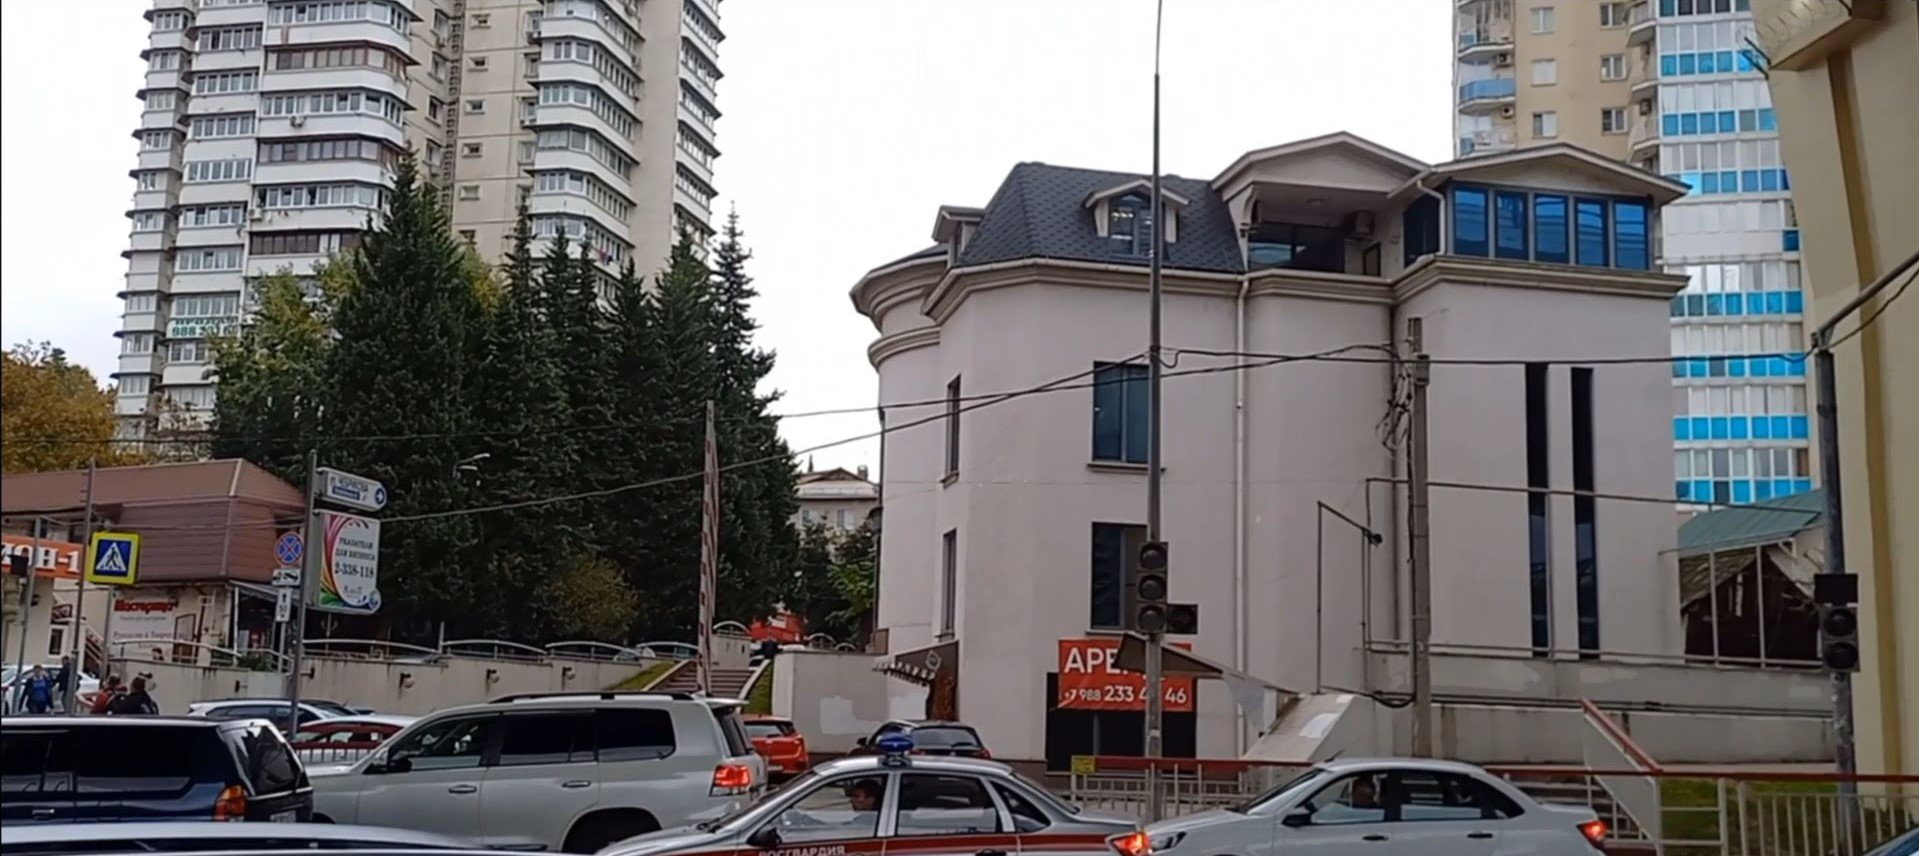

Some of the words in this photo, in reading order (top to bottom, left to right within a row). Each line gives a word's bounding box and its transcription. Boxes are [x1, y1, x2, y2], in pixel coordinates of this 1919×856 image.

[1063, 646, 1148, 680] АРЕ
[1064, 689, 1077, 701] +7
[1104, 685, 1134, 703] 233
[1165, 687, 1187, 704] 46
